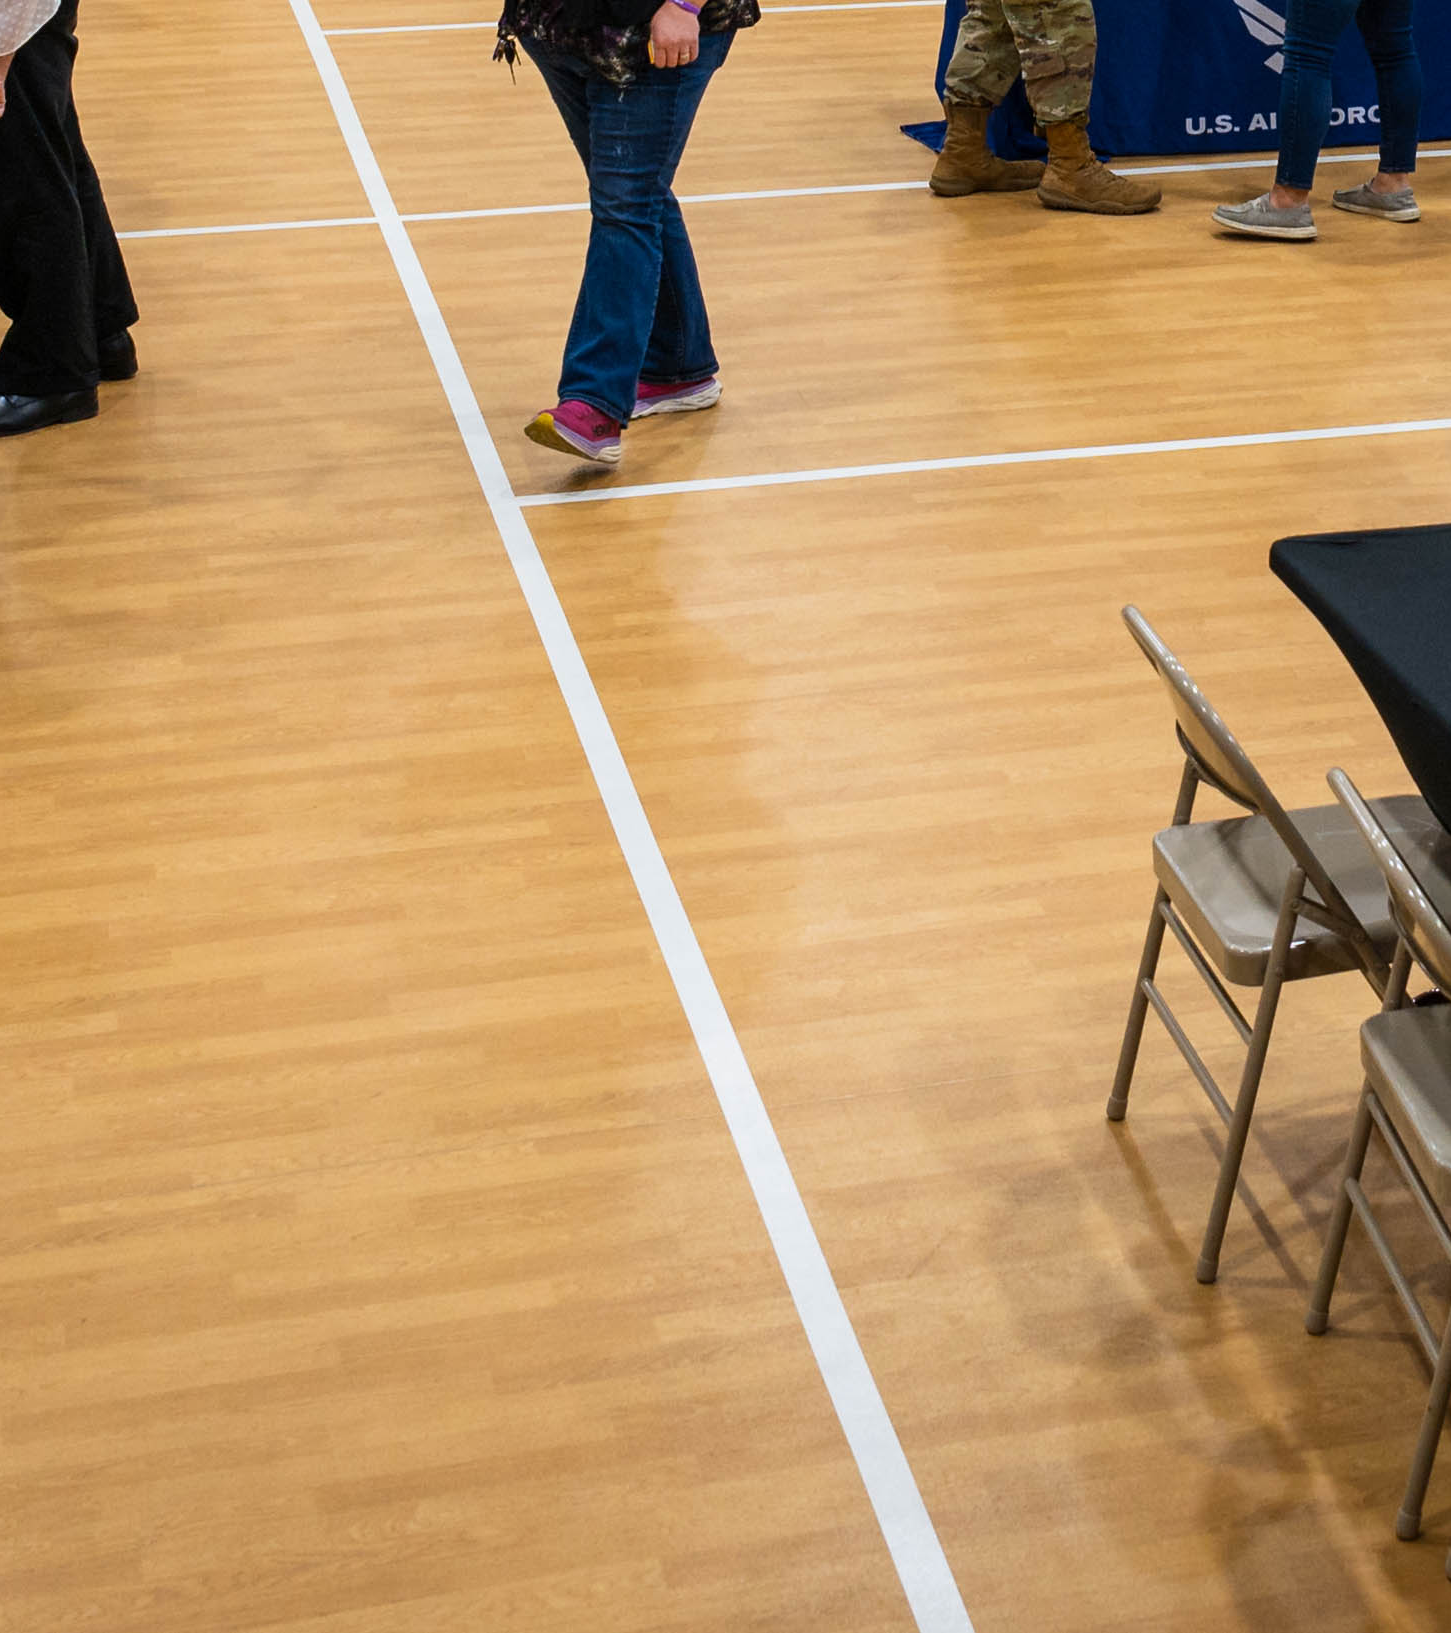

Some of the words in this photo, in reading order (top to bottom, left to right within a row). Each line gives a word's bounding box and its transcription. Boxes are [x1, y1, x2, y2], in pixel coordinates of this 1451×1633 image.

[1185, 114, 1241, 135] U.S.
[1247, 112, 1278, 131] AI
[1329, 104, 1381, 126] ORC
